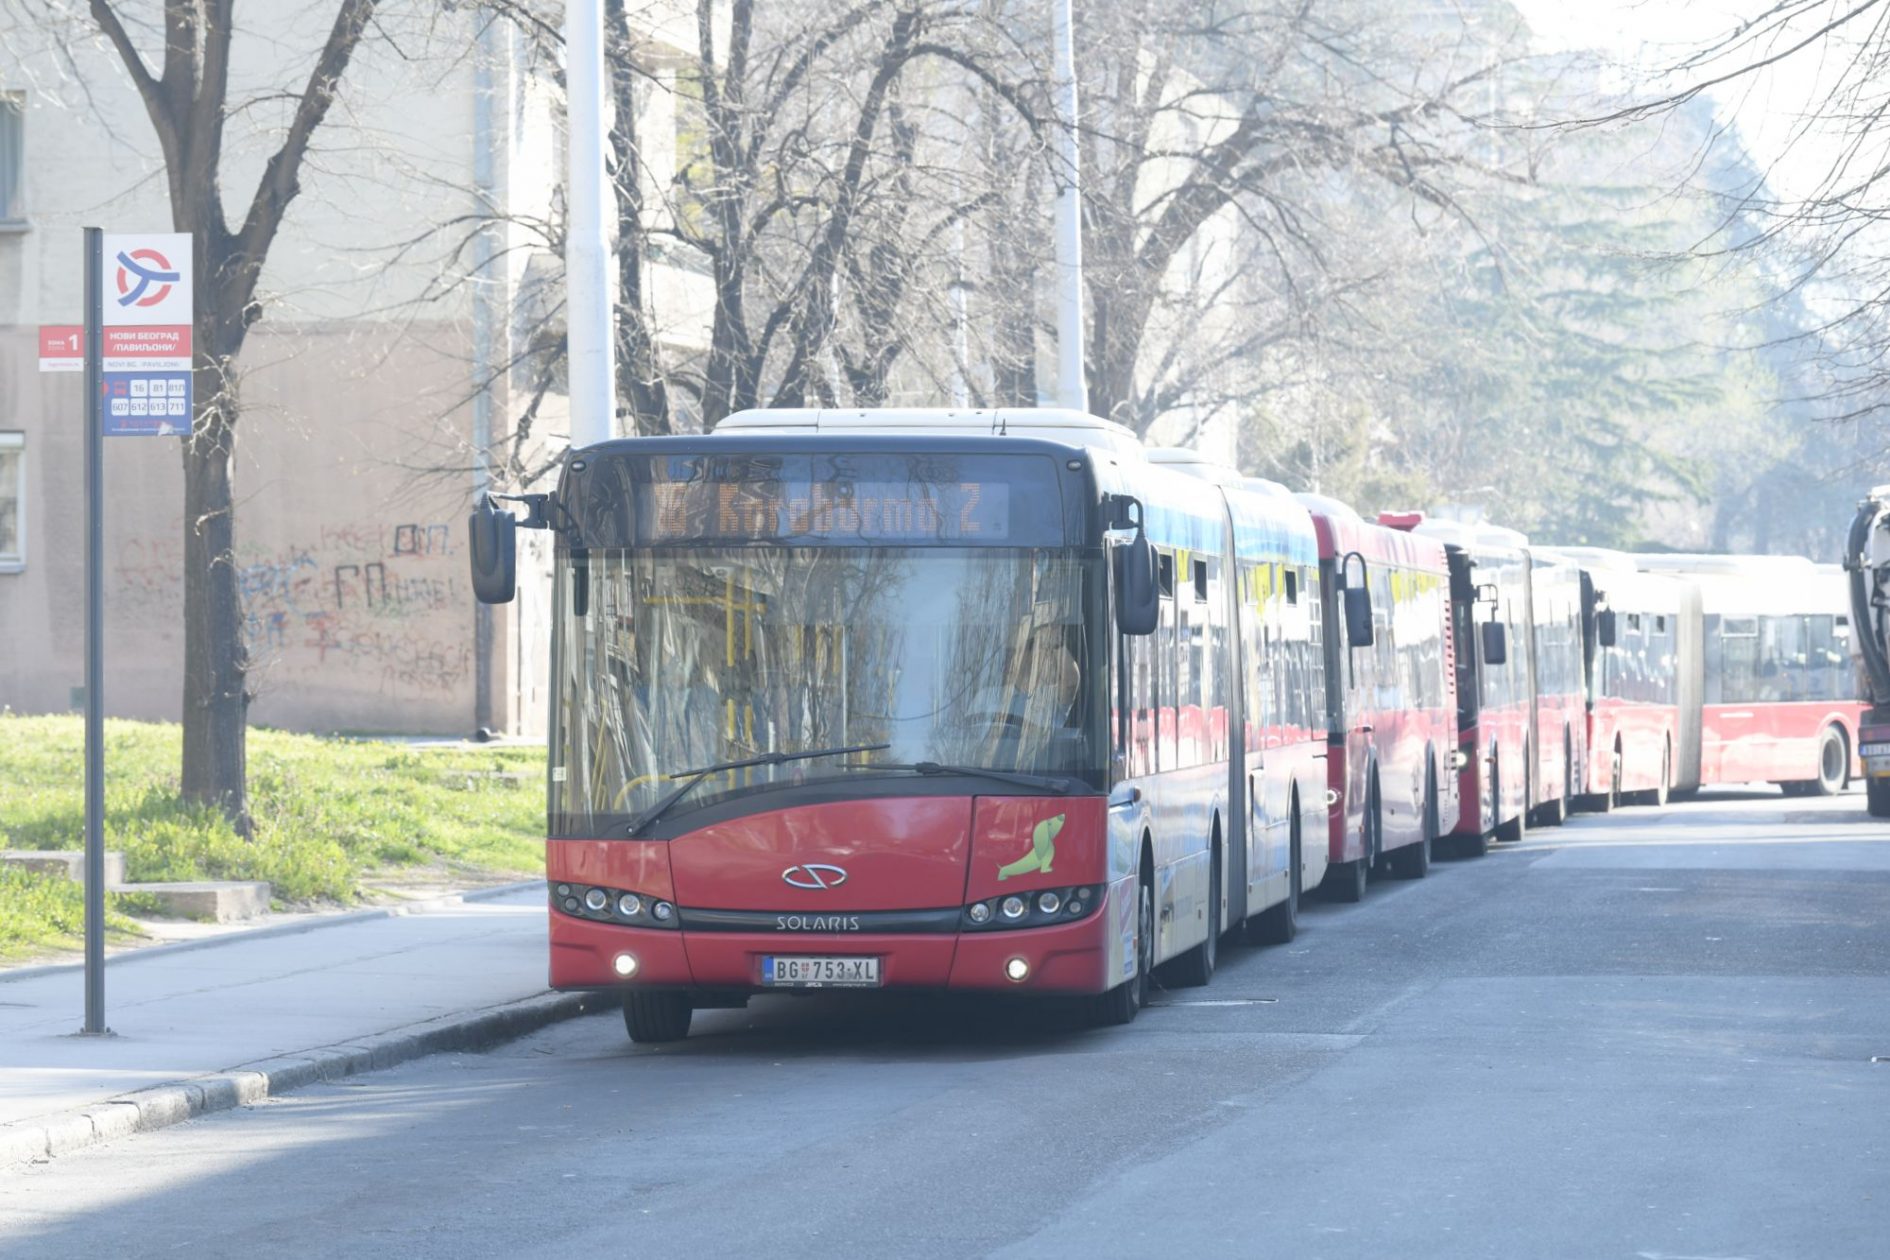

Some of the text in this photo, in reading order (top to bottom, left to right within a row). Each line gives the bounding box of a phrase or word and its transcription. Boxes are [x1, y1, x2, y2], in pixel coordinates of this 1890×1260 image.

[68, 334, 78, 351] 1
[109, 332, 180, 342] НОВИ БЕОГРАД
[134, 384, 145, 393] 16
[131, 403, 147, 412] 612
[150, 403, 166, 412] 613
[169, 403, 184, 412] 711
[960, 482, 981, 532] 2
[776, 916, 860, 930] SOLARIS
[777, 961, 799, 979] BG
